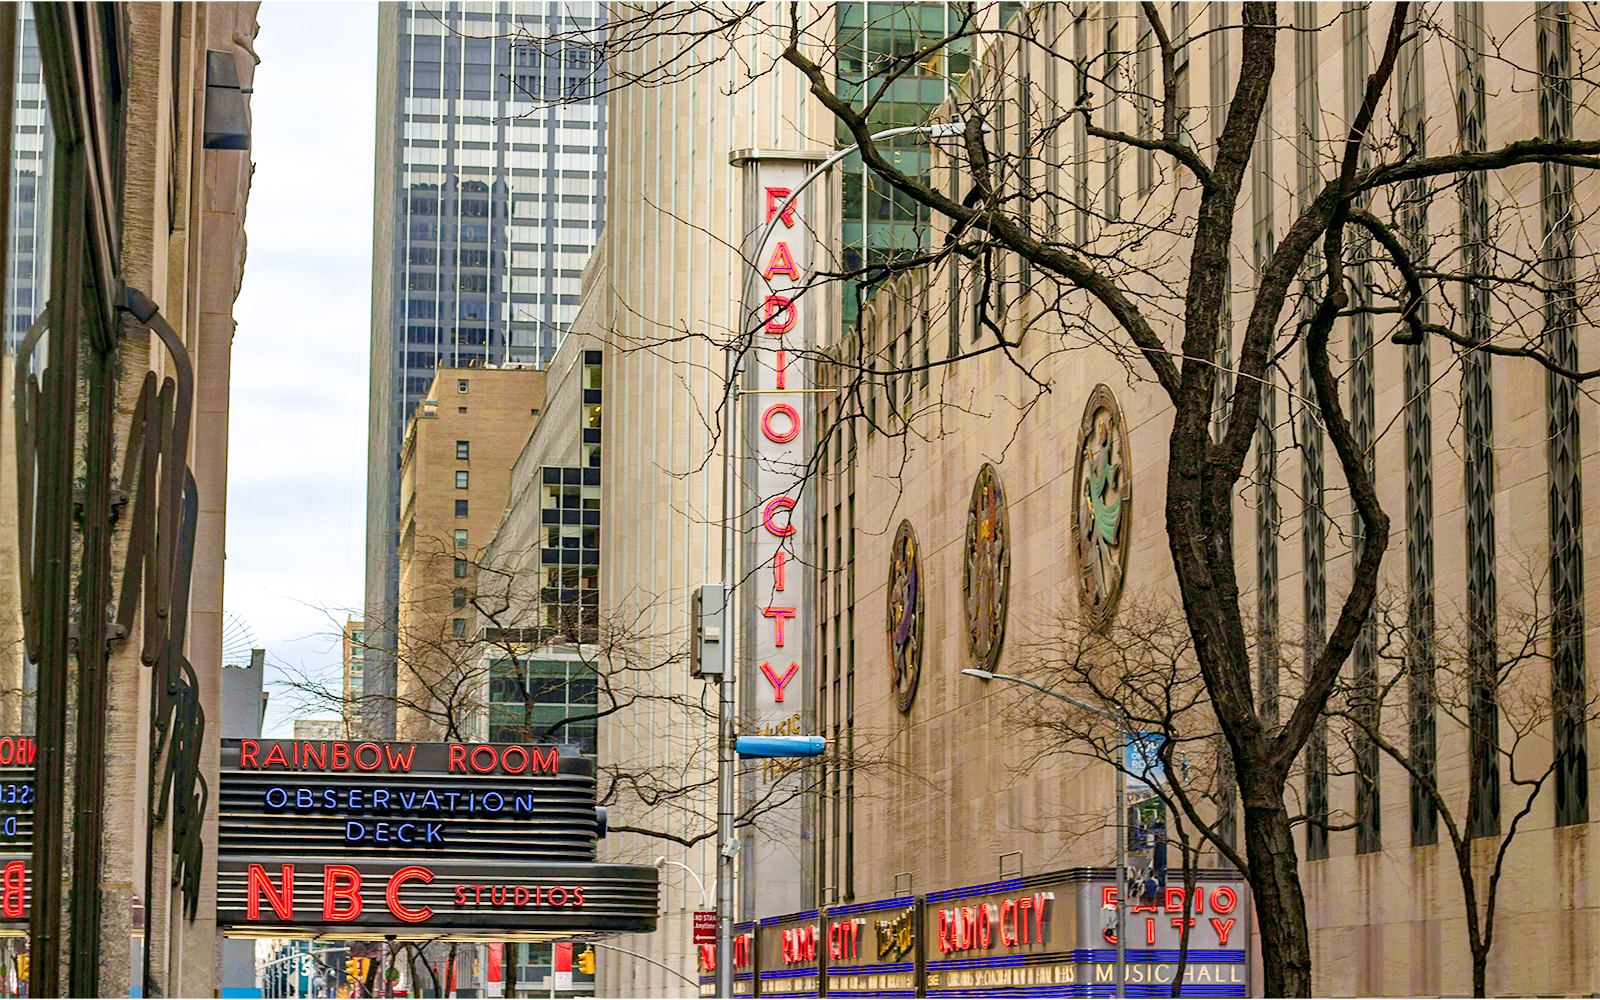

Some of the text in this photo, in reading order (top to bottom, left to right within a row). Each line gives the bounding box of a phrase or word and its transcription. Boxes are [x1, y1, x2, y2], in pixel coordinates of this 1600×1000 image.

[760, 187, 801, 702] RADIO CITY
[240, 740, 559, 775] RAINBOW ROOM
[265, 787, 533, 812] OBSERVATION
[346, 821, 443, 843] DECK
[246, 863, 585, 922] NBC STUDIOS
[1102, 886, 1238, 914] RDIO
[938, 902, 992, 954] RADIO
[999, 893, 1050, 948] CITY
[1102, 918, 1235, 945] ITY
[1184, 963, 1242, 983] HALL
